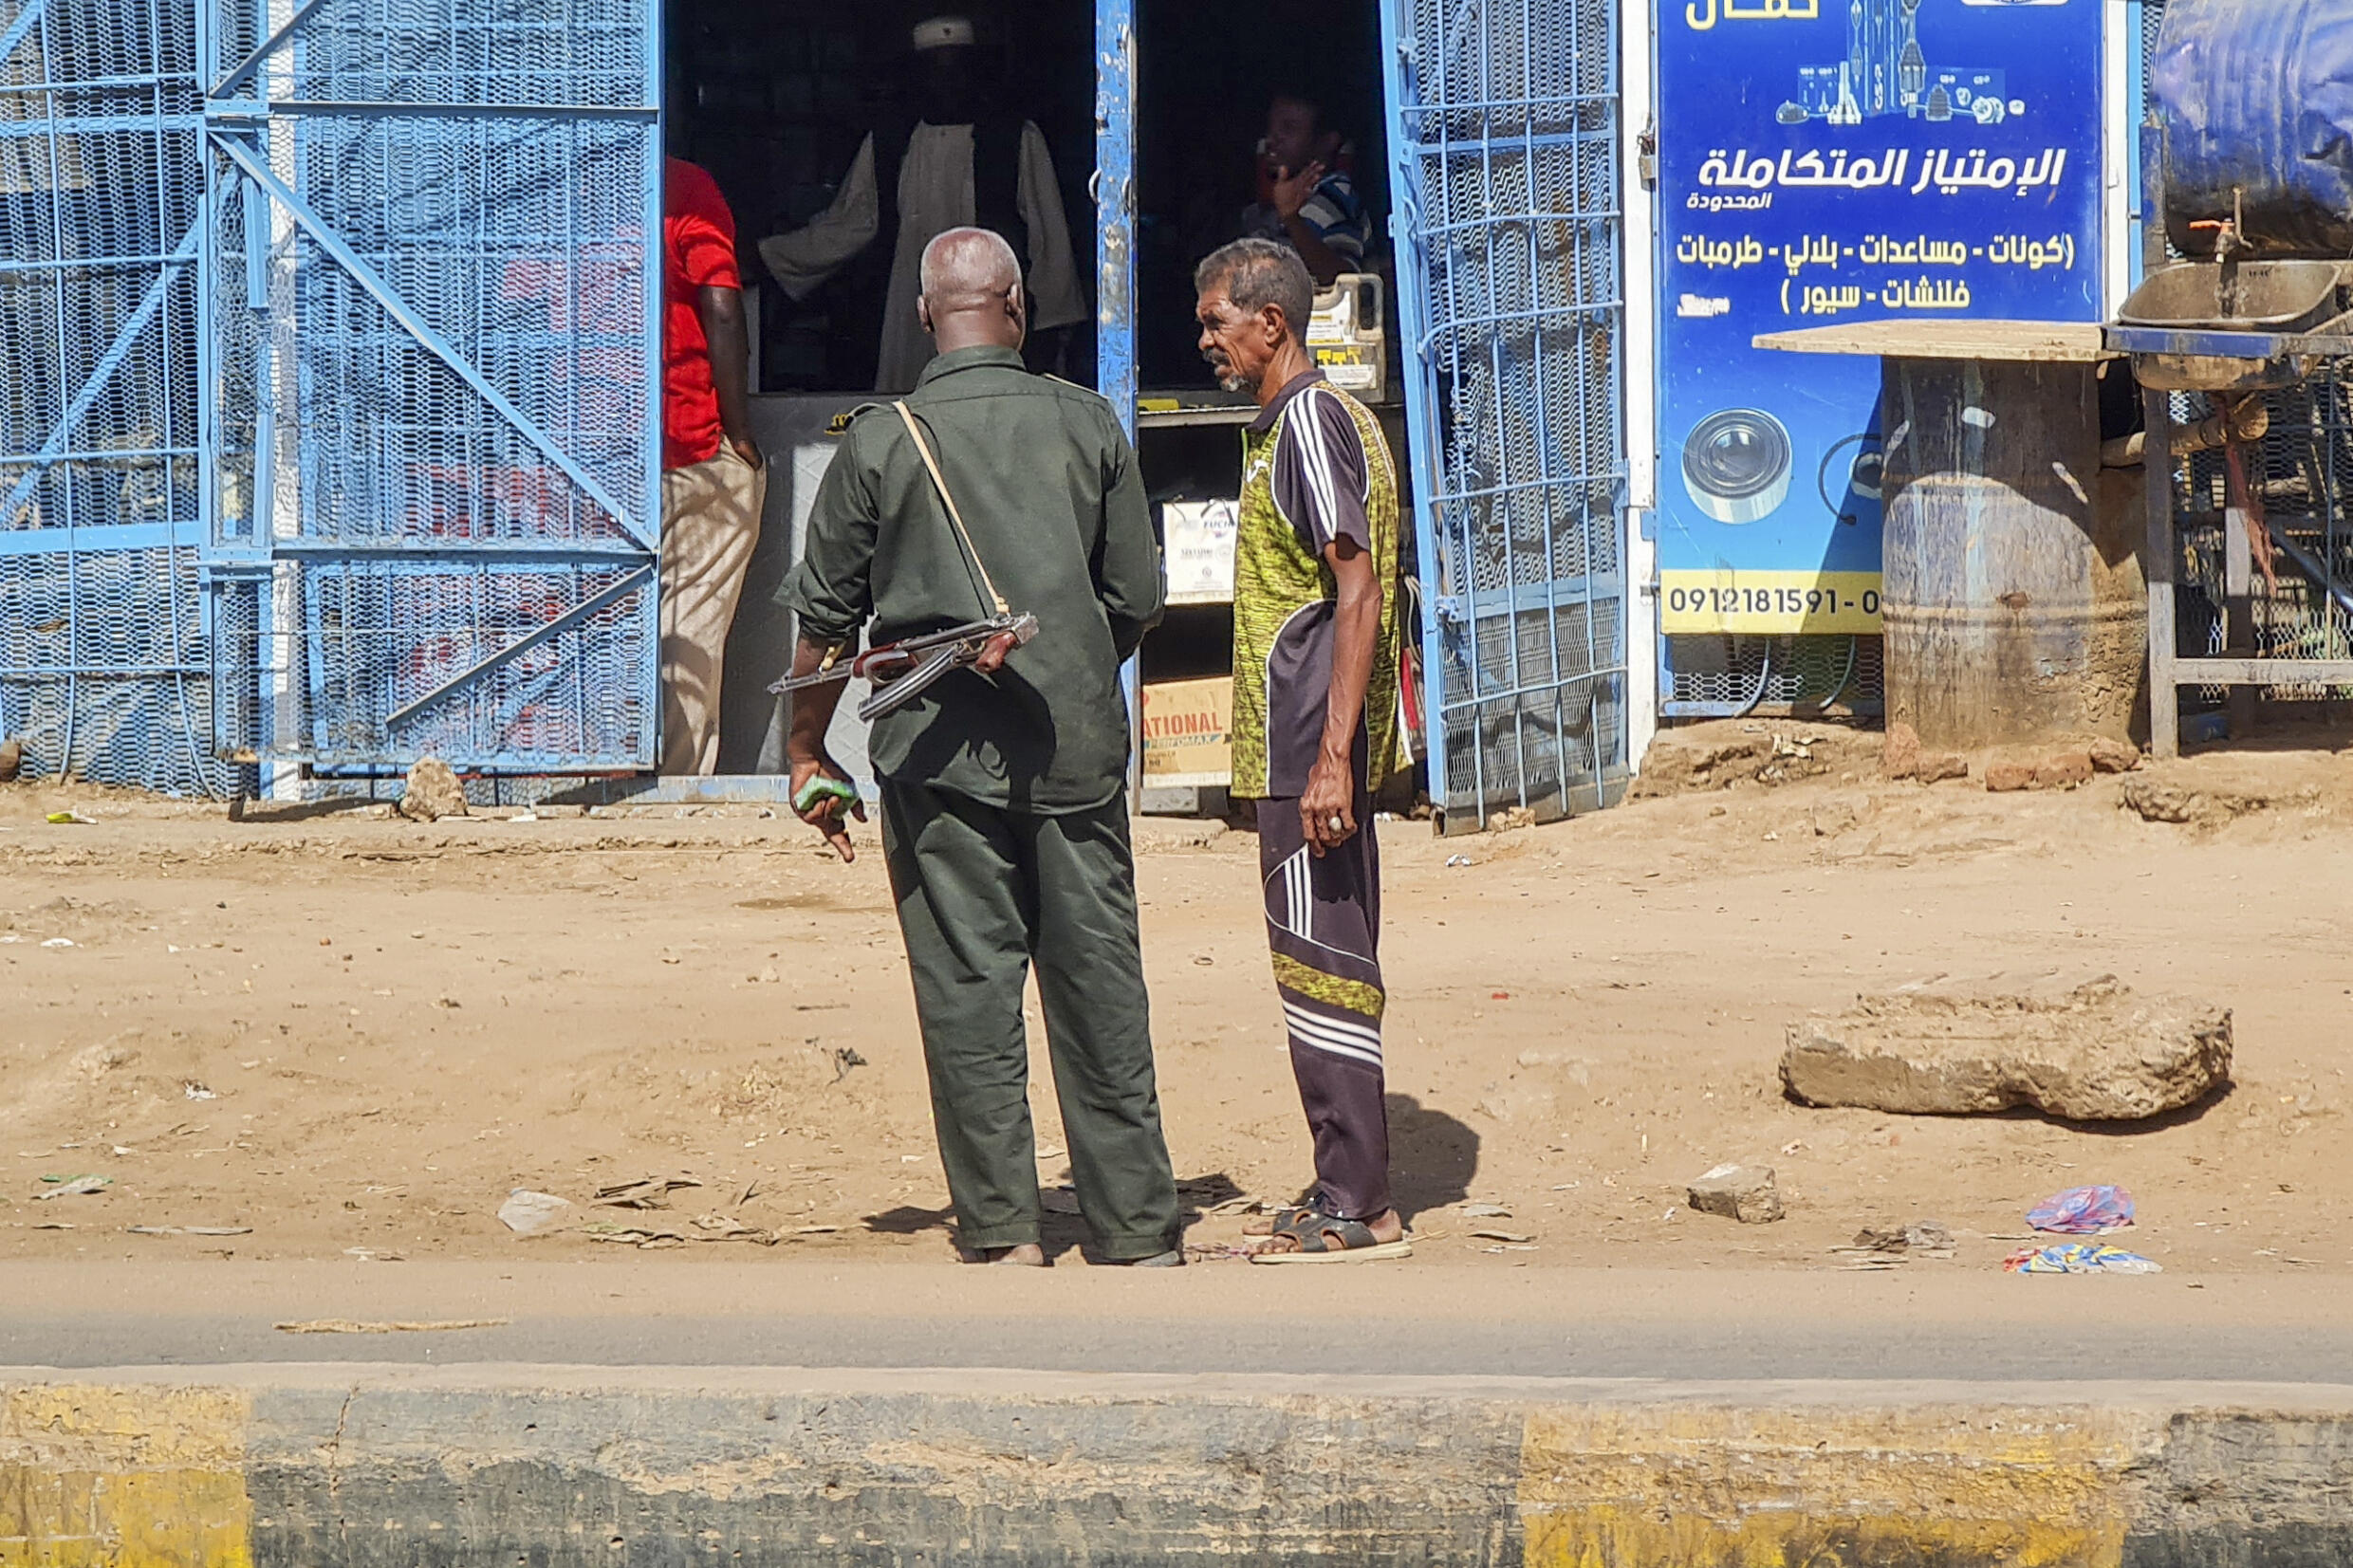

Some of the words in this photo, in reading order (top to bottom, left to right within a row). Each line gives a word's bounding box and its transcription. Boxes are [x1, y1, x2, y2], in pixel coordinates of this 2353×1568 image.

[1698, 148, 1909, 189] المتكاملة
[1911, 148, 2066, 196] الإمتياز
[1686, 192, 1772, 212] المحدودة
[1677, 234, 1763, 269] طرمبات
[1784, 234, 1838, 276] بلالي
[1859, 234, 1967, 266] مساعدات
[1800, 286, 1861, 315] سيور
[1881, 275, 1971, 308] فلنشات
[1670, 588, 1882, 615] 0912181591-0
